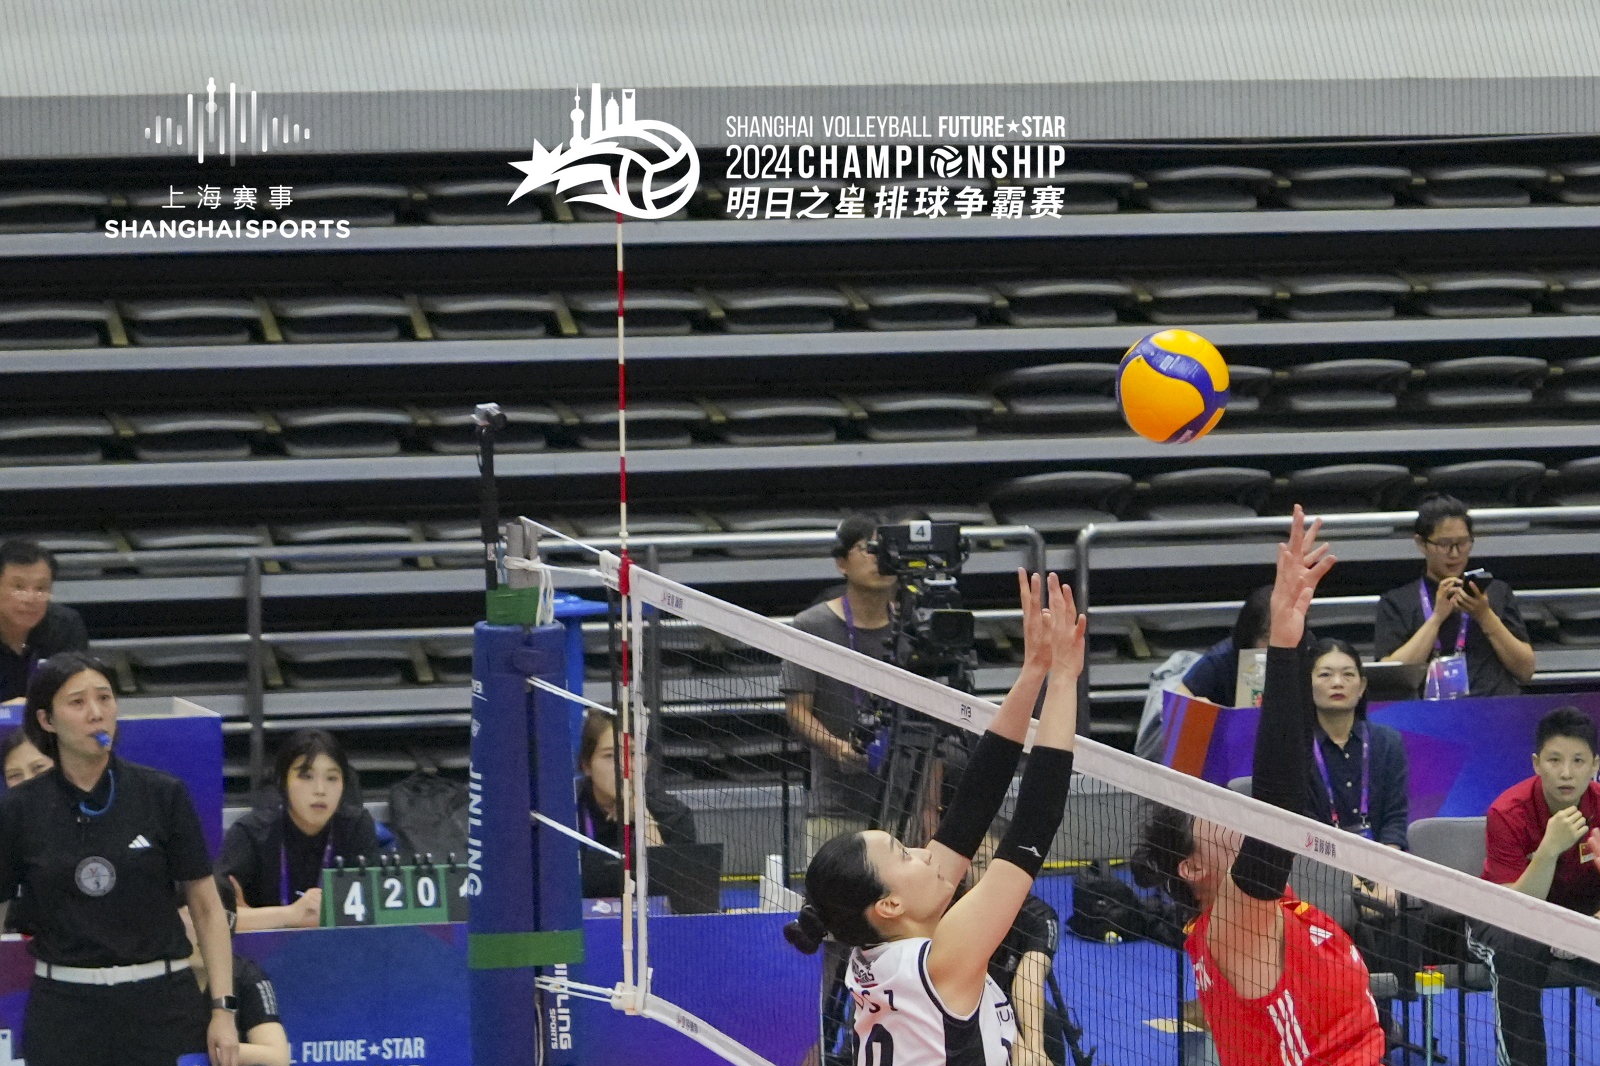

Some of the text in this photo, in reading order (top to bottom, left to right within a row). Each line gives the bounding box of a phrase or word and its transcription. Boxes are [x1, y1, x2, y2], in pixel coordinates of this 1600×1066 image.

[916, 525, 926, 537] 4
[467, 762, 483, 896] JINLING
[344, 881, 366, 922] 4
